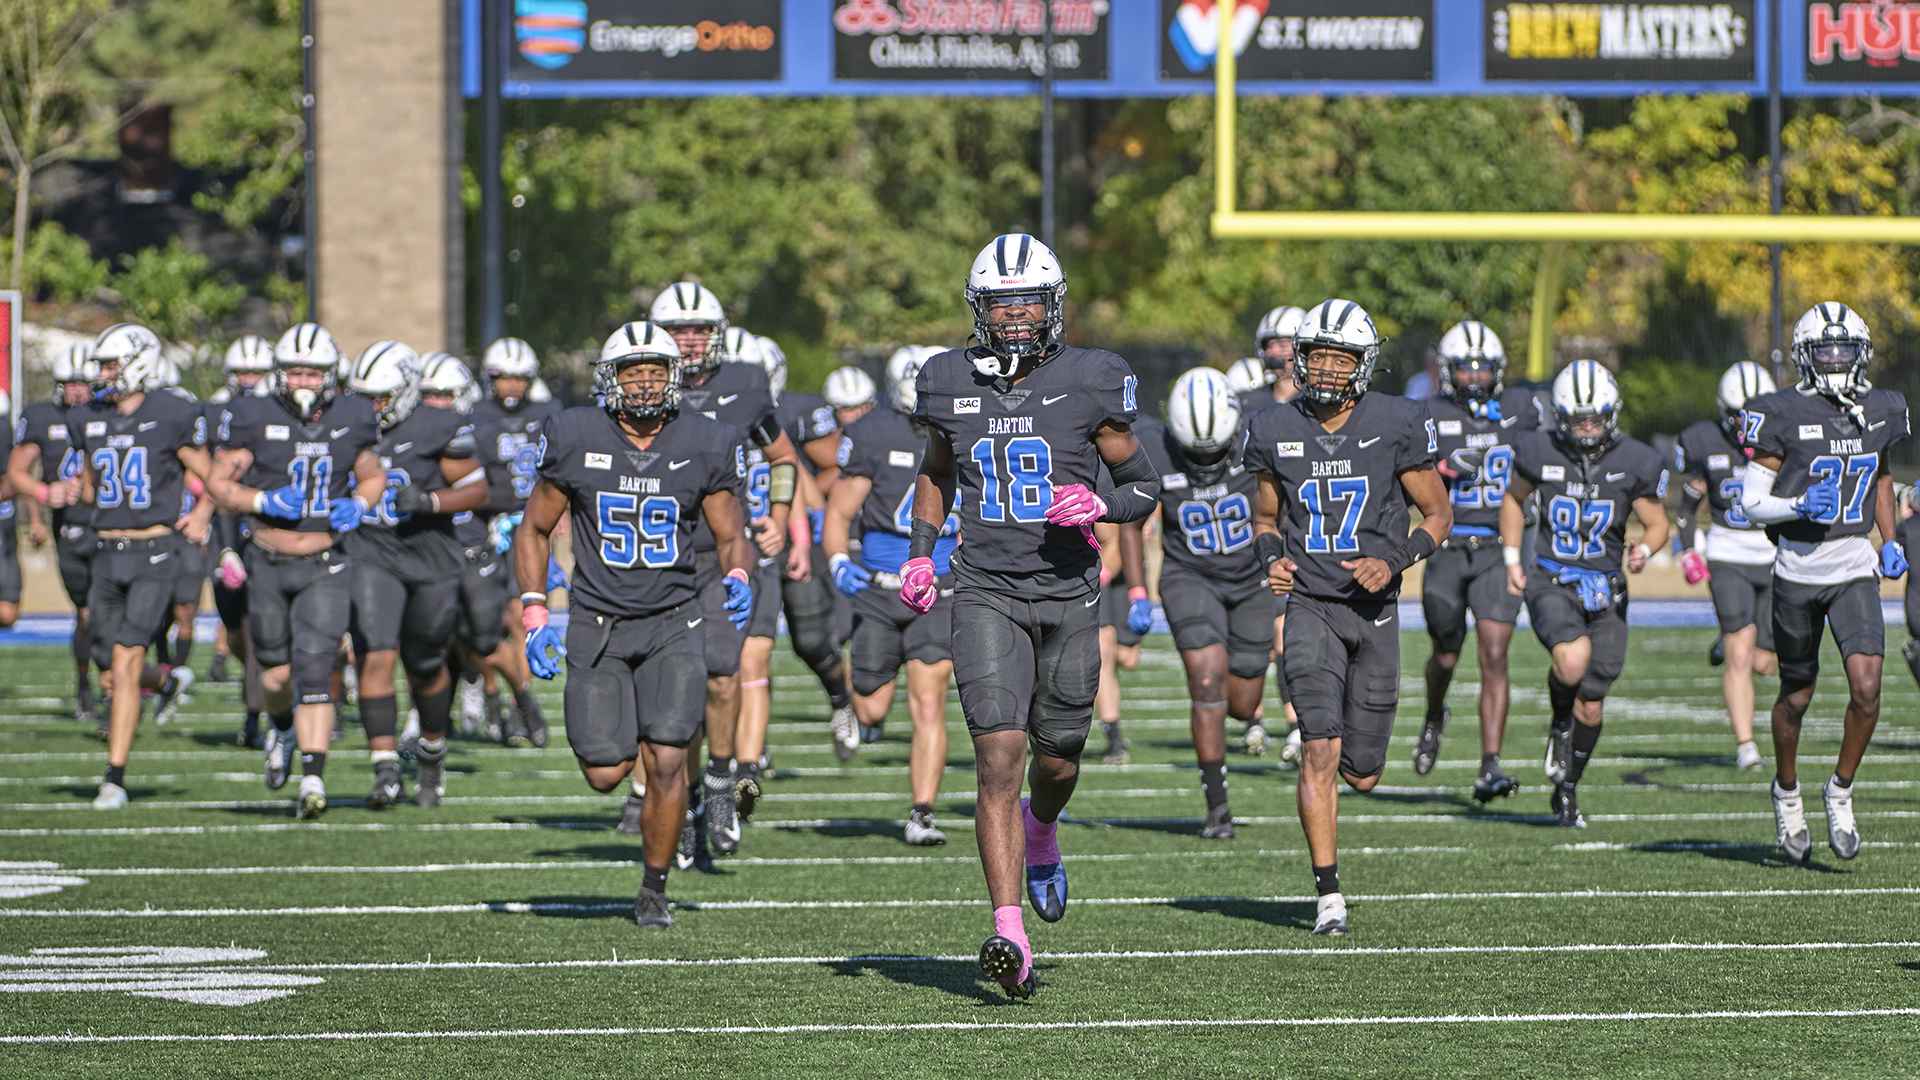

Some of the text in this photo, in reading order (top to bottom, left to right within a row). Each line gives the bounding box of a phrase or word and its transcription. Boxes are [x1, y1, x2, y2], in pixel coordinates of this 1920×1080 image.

[589, 20, 775, 57] EmergeOrtho
[1306, 16, 1424, 50] WOOTEN
[958, 400, 979, 408] SAC
[988, 417, 1033, 434] BARTON
[1311, 460, 1352, 476] BARTON
[1830, 439, 1863, 454] BARTON
[91, 447, 151, 509] 34
[287, 456, 333, 518] 11
[619, 475, 661, 494] BARTON
[971, 436, 1054, 523] 18
[1809, 452, 1879, 524] 37
[596, 491, 680, 569] 59
[1177, 492, 1253, 556] 92
[1298, 476, 1370, 553] 17
[1548, 494, 1615, 560] 87
